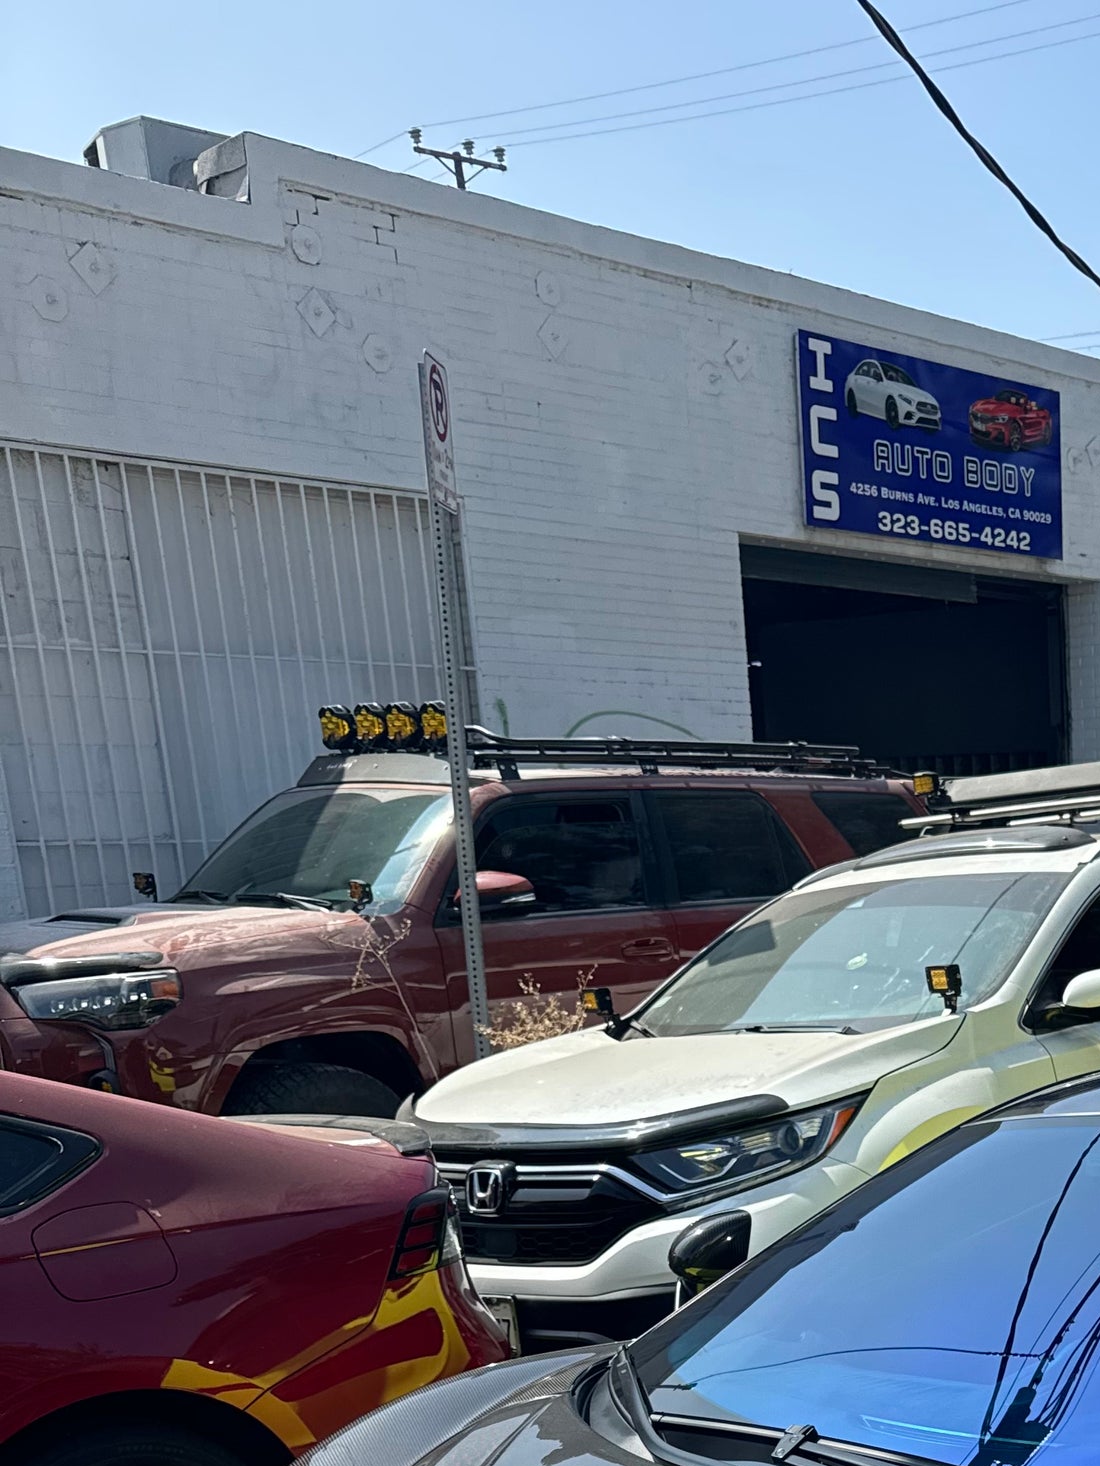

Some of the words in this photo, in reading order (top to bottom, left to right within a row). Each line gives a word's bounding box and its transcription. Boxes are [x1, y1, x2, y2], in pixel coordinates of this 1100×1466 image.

[807, 337, 841, 521] ICS
[873, 439, 952, 483] AUTO
[964, 456, 1035, 497] BODY
[850, 482, 878, 497] 4256
[1008, 506, 1021, 520] CA
[1023, 508, 1052, 524] 90029
[877, 511, 1031, 551] 323-665-4242
